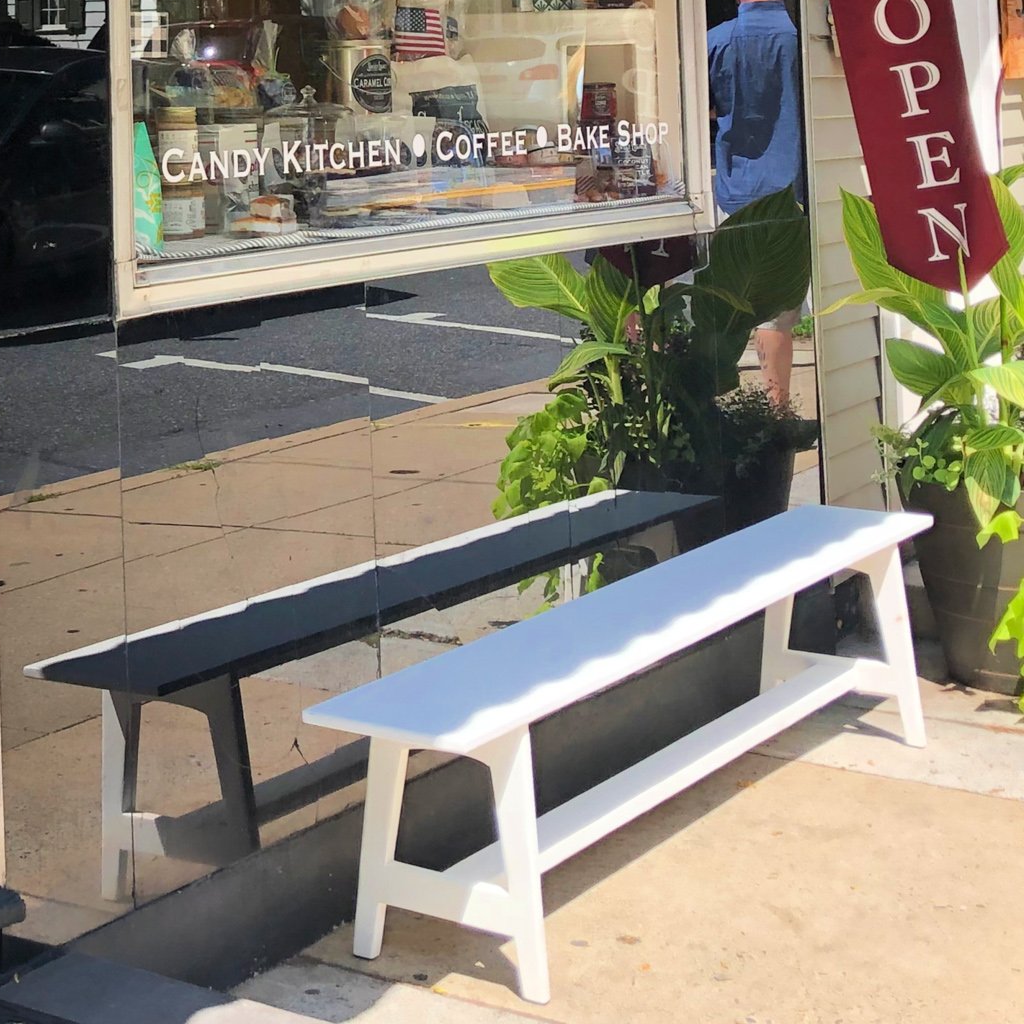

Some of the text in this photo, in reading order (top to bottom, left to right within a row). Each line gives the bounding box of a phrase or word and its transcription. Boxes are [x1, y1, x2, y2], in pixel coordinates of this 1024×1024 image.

[353, 77, 383, 88] CARAMEL
[161, 147, 271, 183] CANDY
[282, 138, 401, 174] KITCHEN
[436, 129, 528, 162] COFFEE
[557, 123, 611, 151] BAKE
[617, 119, 669, 146] SHOP
